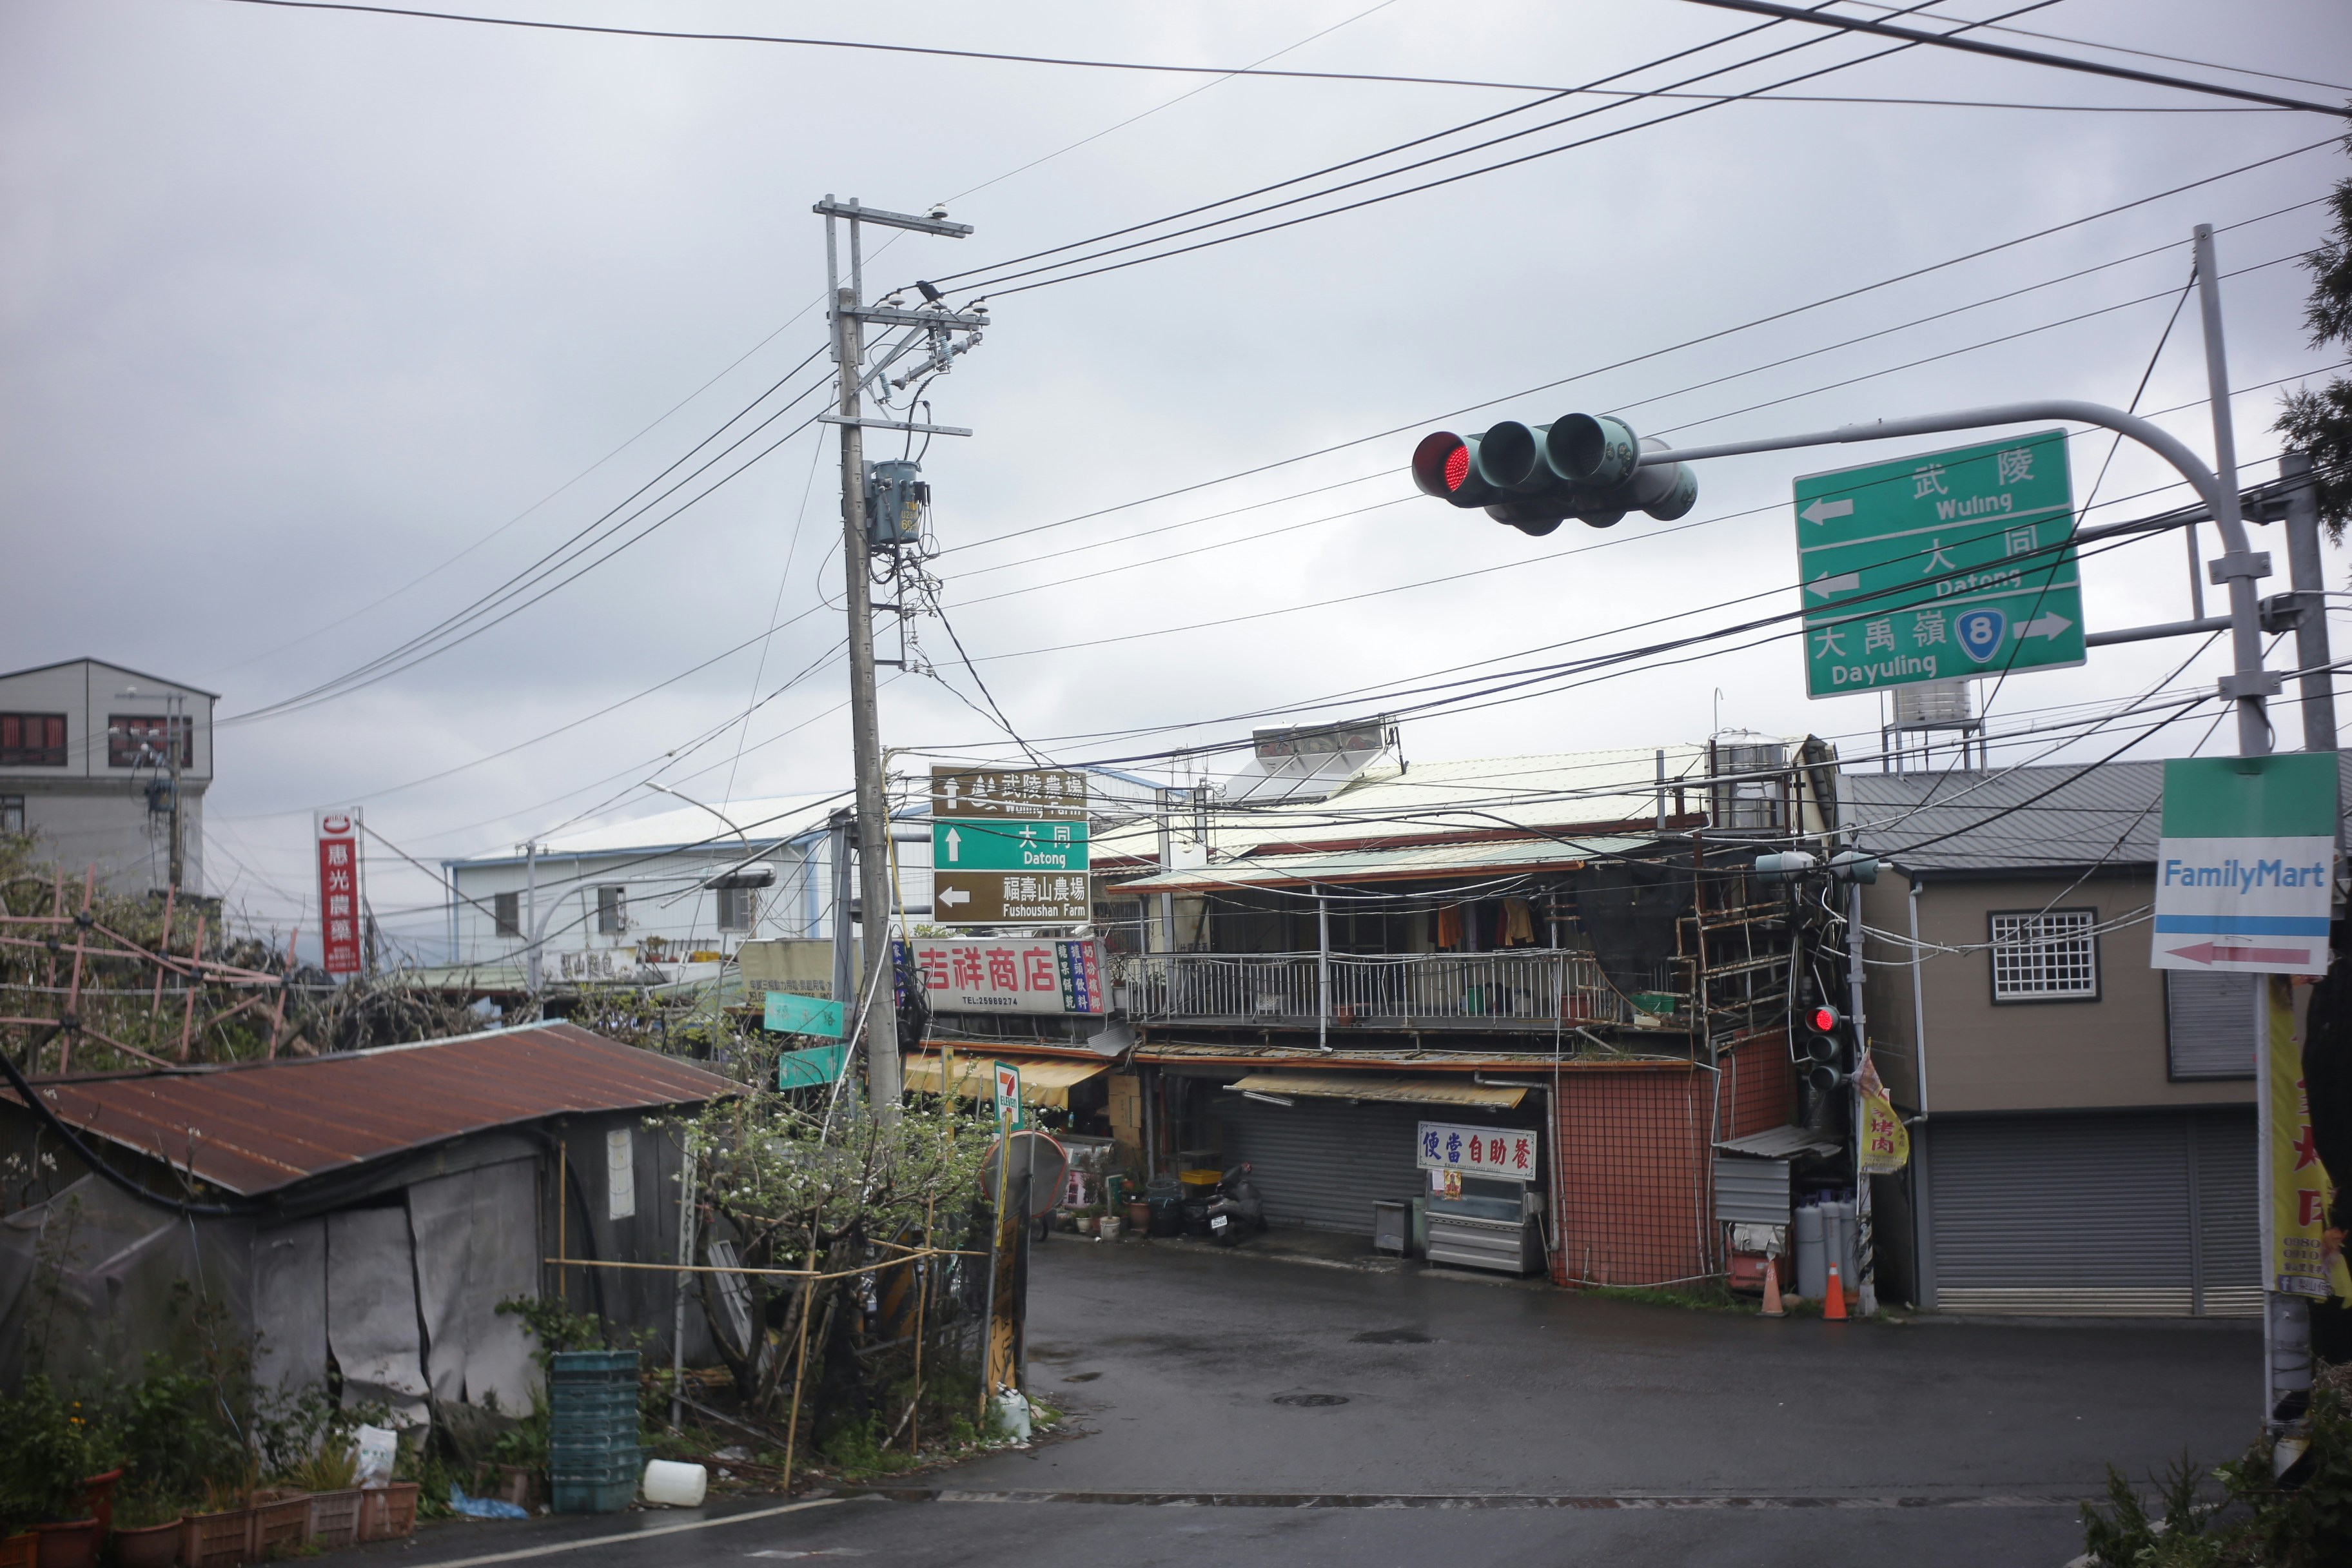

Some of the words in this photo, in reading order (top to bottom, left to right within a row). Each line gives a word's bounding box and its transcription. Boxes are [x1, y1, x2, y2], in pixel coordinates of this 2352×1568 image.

[1912, 447, 2035, 500] 武陵
[1936, 493, 2013, 520] Wuling
[1921, 524, 2037, 573] 大同
[1936, 567, 2021, 597] Datong
[1815, 610, 1946, 660] 大禹嶺
[1969, 616, 1992, 644] 8
[1832, 653, 1937, 685] Dayuling
[1001, 774, 1083, 800] 武陵農場
[1019, 825, 1071, 849] 大同
[1024, 851, 1066, 868] Datong
[1003, 876, 1084, 901] 福壽山農場
[2164, 859, 2324, 895] FamilyMart
[1003, 903, 1058, 917] Fushoushan
[1064, 903, 1085, 916] Farm
[919, 946, 1055, 992] 吉祥商店
[1058, 944, 1075, 1009] 糖果餅乾
[1071, 944, 1088, 1010] 罐頭飲料
[963, 996, 1018, 1006] TEL:25989274
